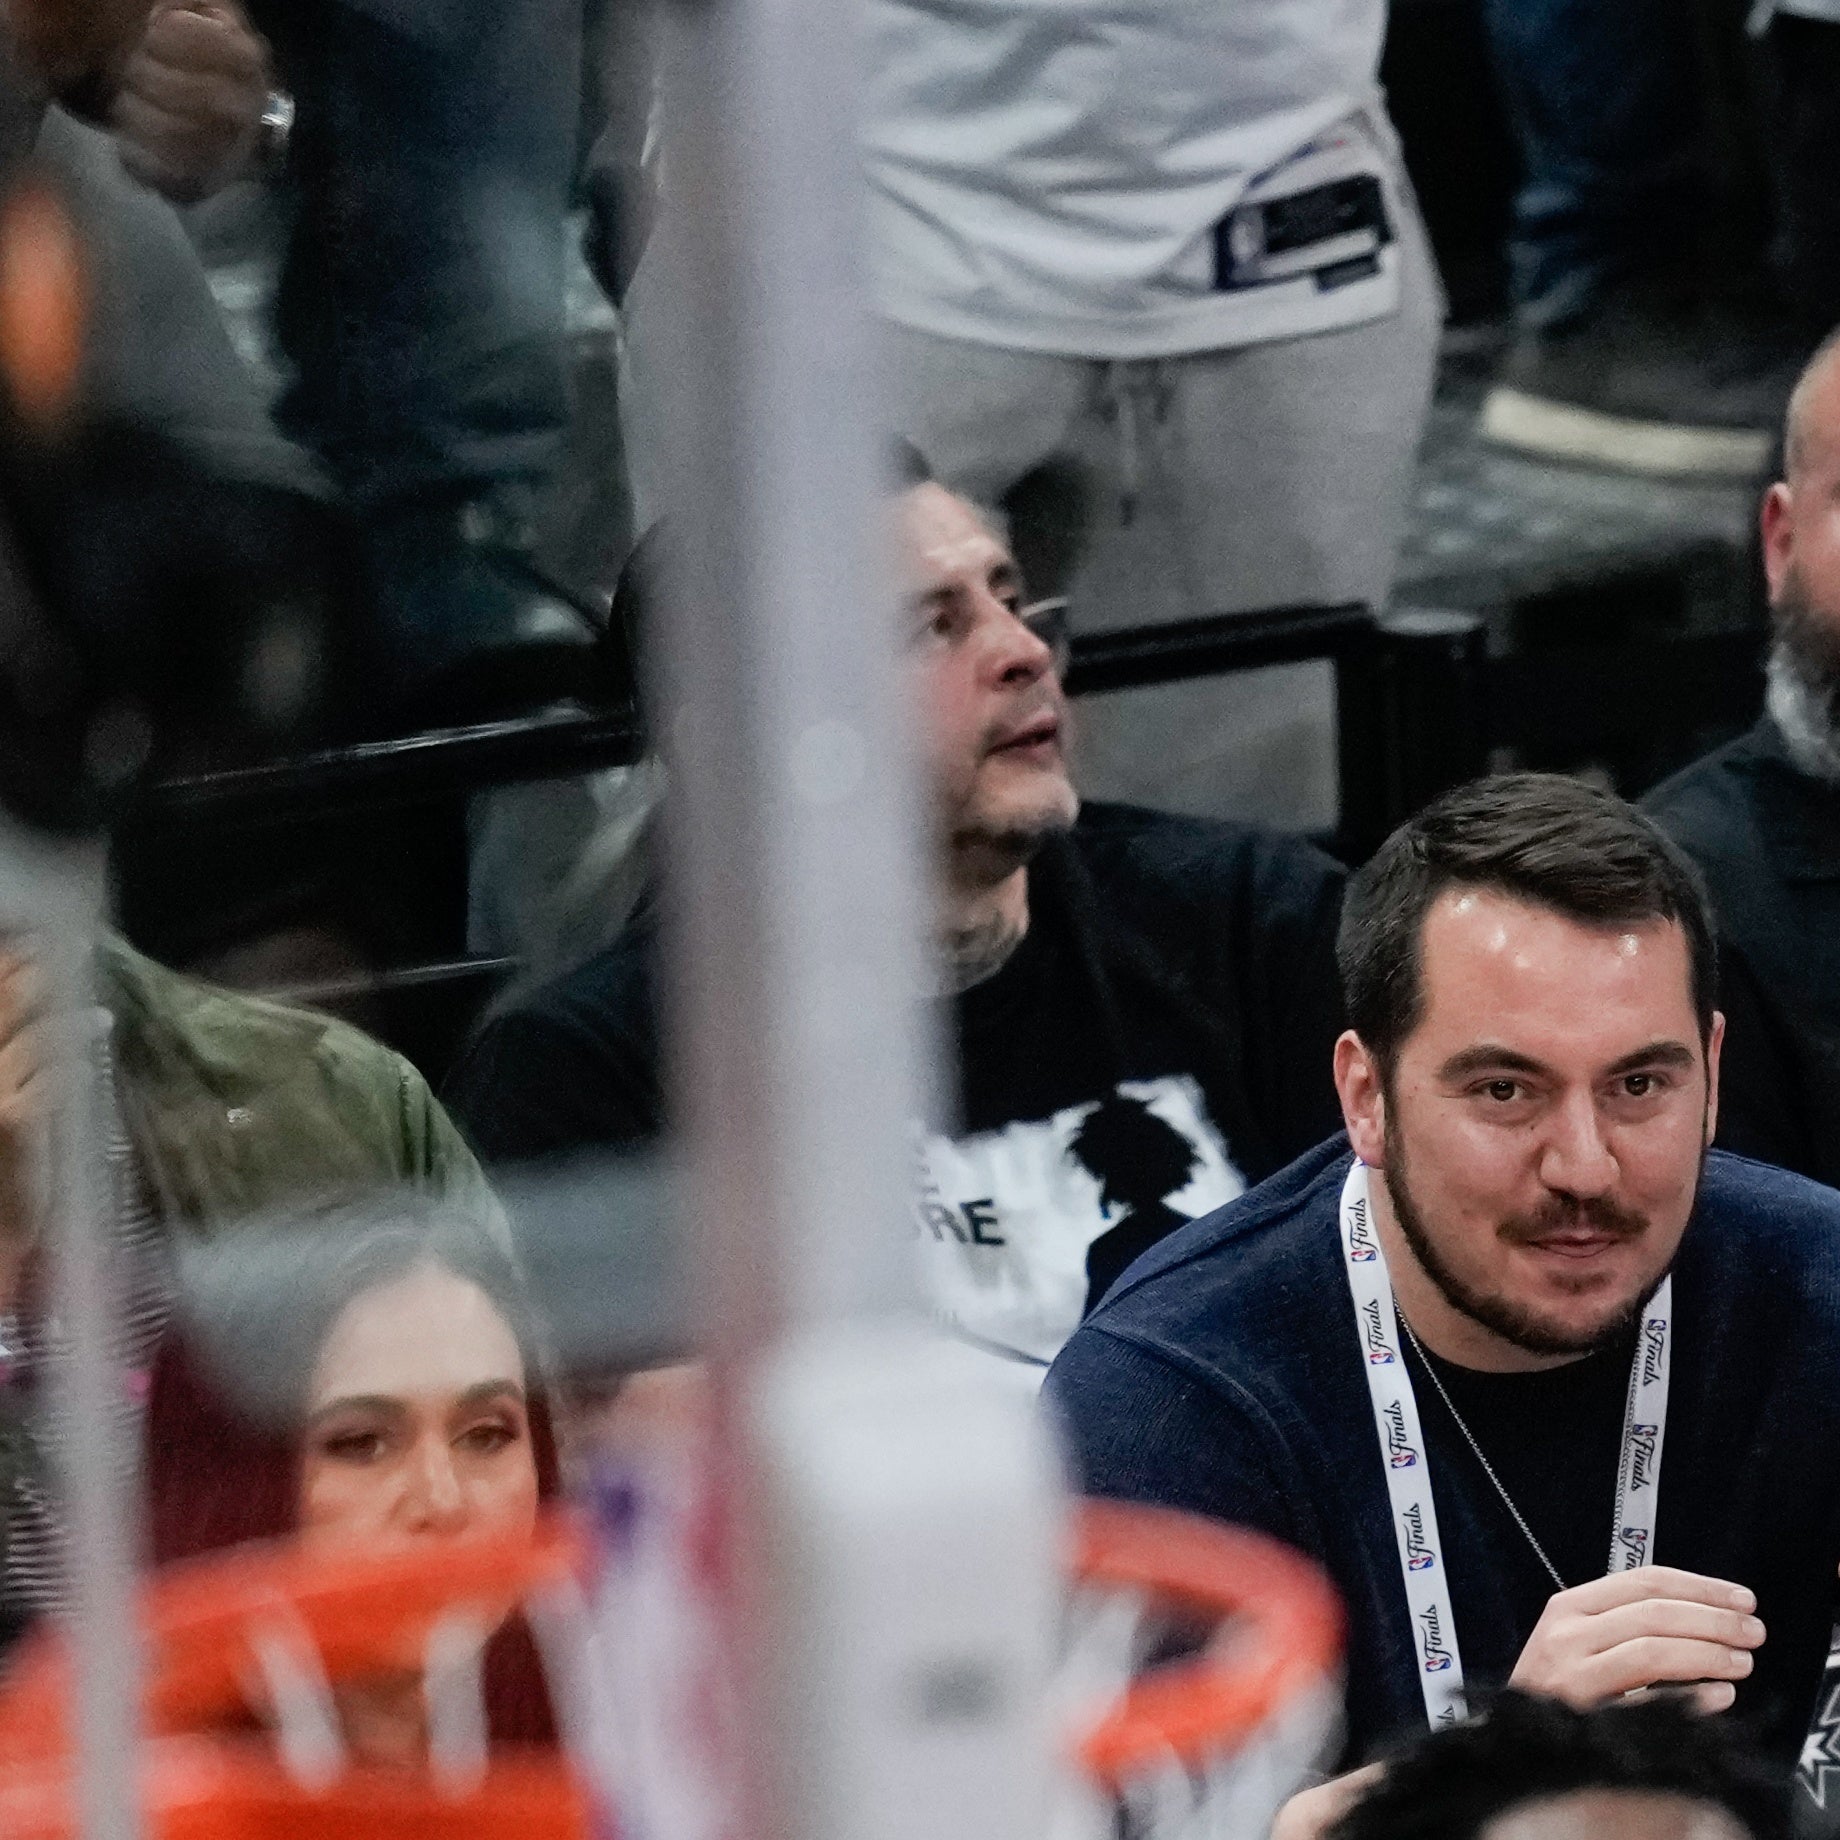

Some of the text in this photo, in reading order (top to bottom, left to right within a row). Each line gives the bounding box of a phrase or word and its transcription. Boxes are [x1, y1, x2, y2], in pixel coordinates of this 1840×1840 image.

[1348, 1198, 1379, 1253] Finals
[1362, 1298, 1398, 1357] Finals
[1642, 1327, 1664, 1387] Finals
[1383, 1399, 1420, 1459] Finals
[1630, 1432, 1656, 1492] Finals
[1403, 1502, 1436, 1558] Finals
[1620, 1537, 1646, 1570] Fin
[1419, 1604, 1454, 1662] Finals
